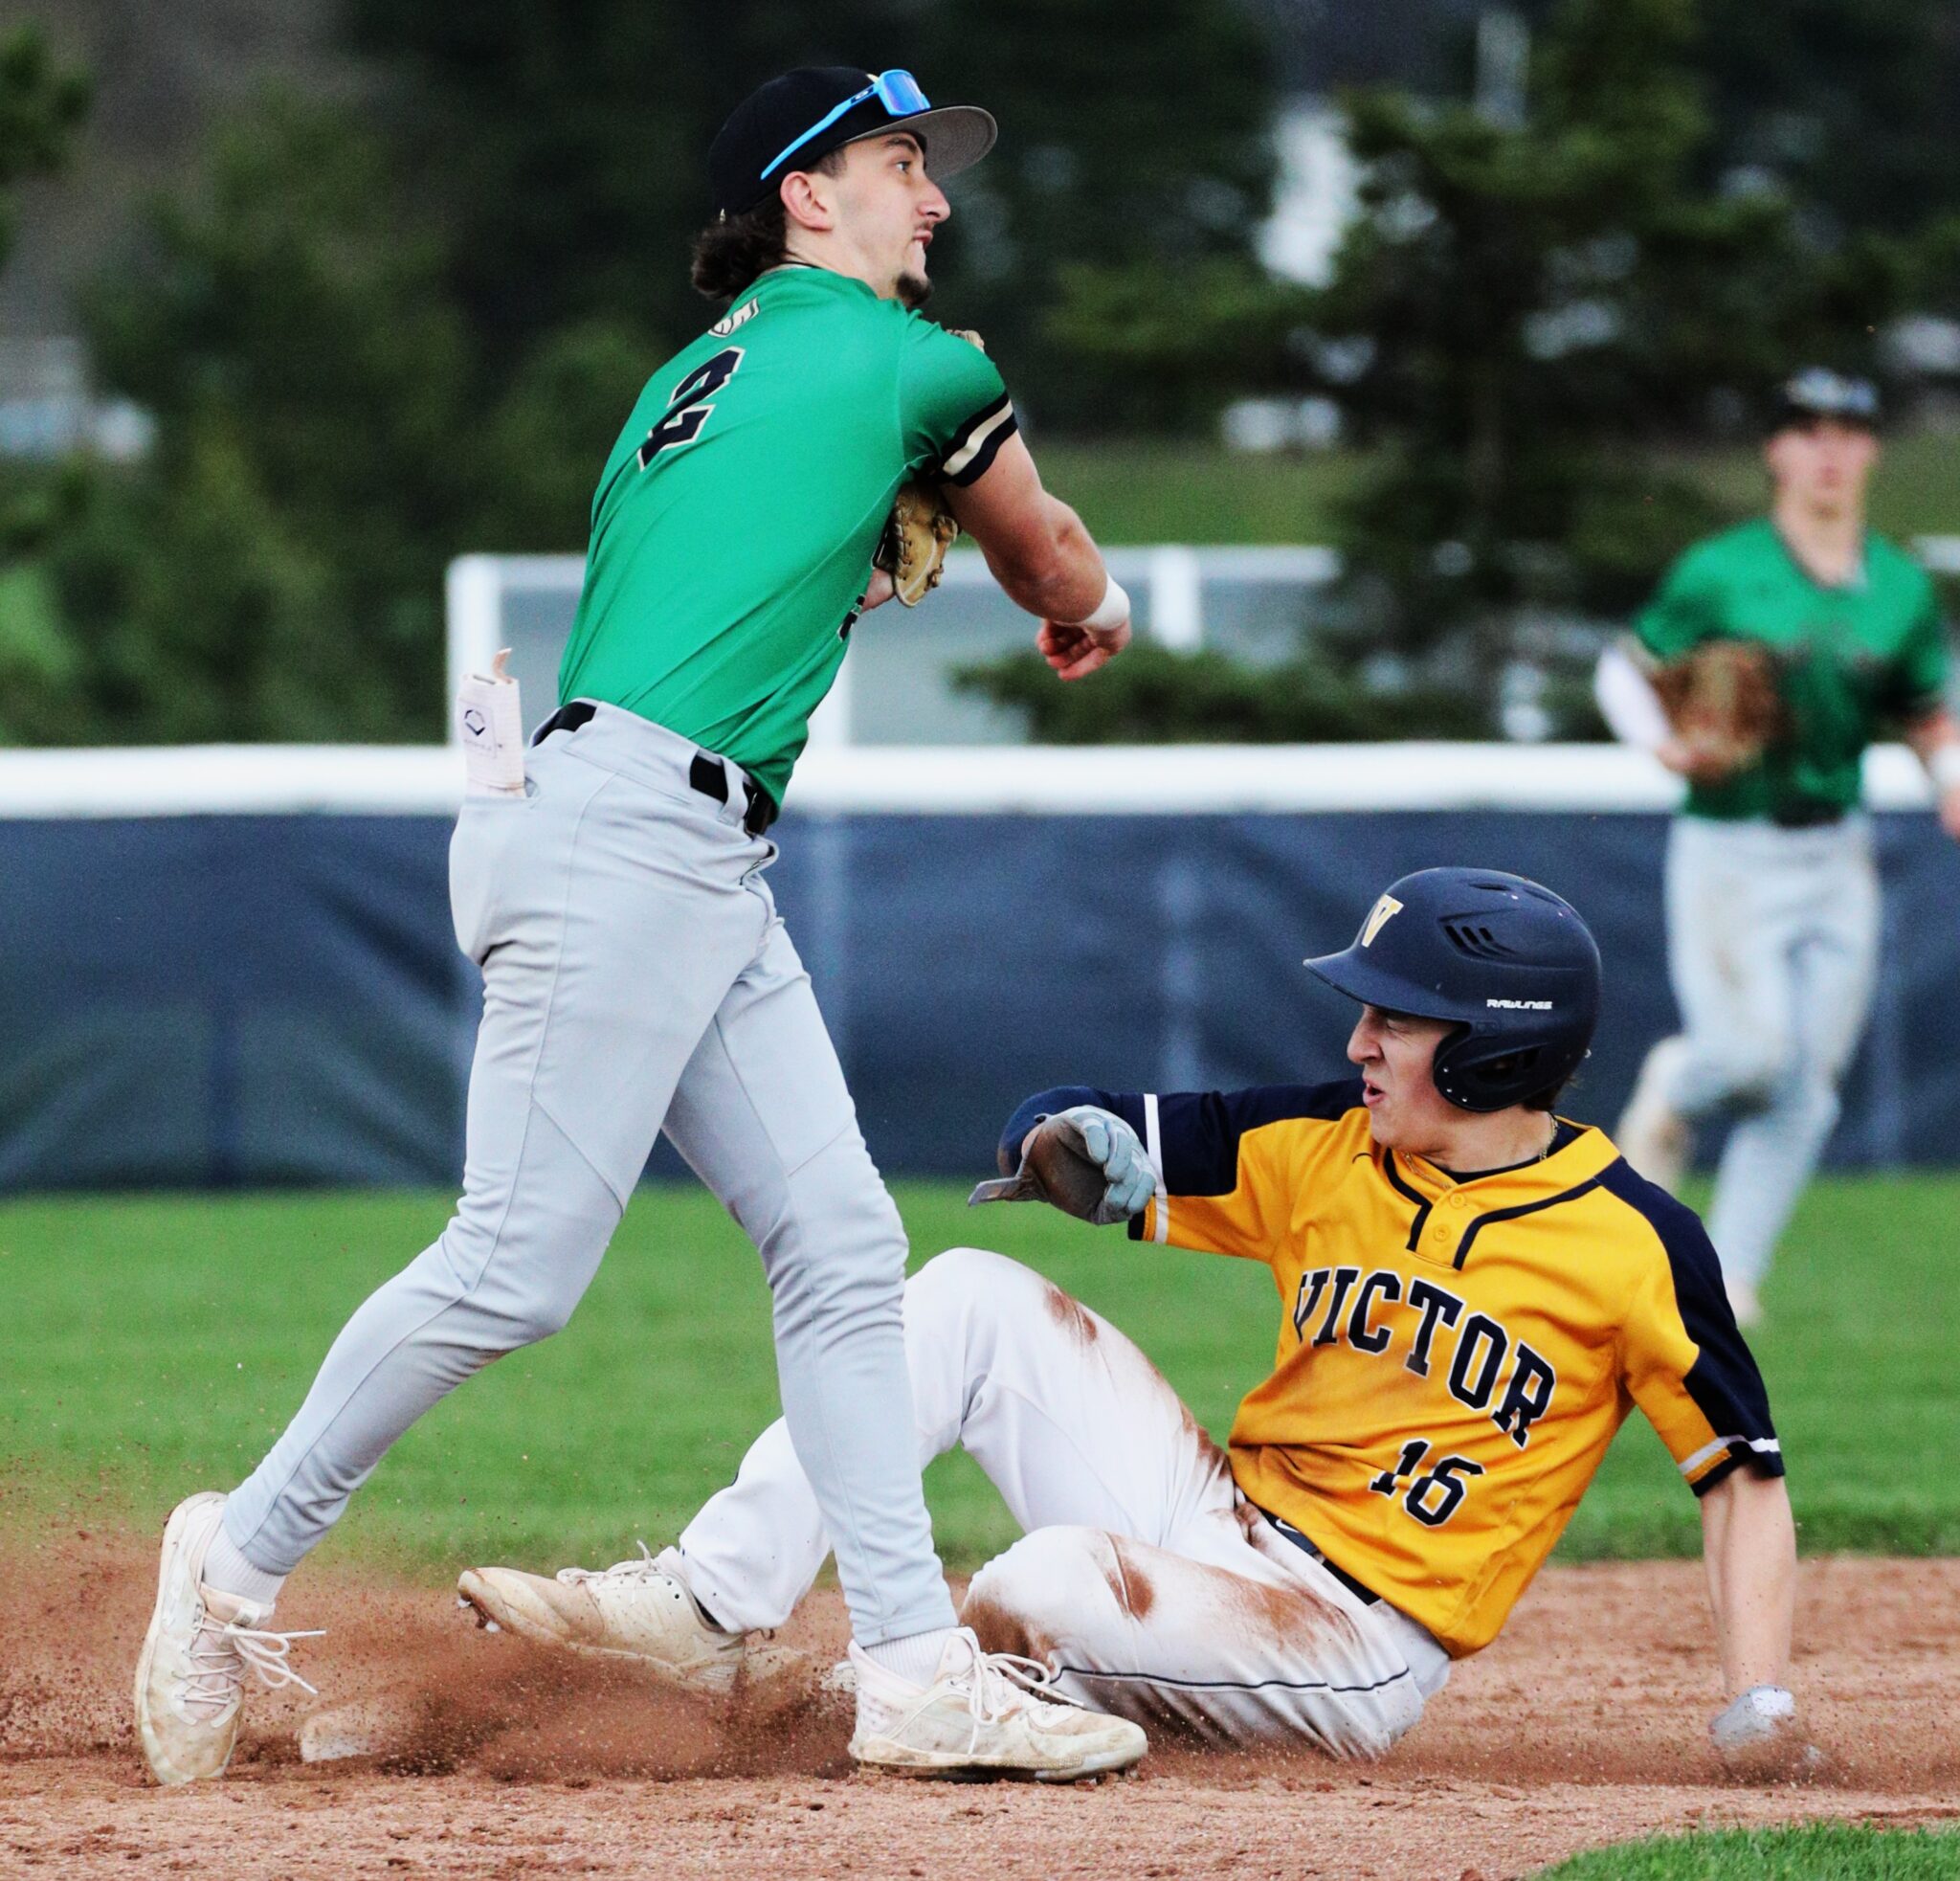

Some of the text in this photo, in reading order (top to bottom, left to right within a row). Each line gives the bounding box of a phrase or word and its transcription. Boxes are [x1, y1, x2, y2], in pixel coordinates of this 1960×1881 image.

[637, 346, 746, 472] 2
[1361, 893, 1404, 948] V
[1486, 998, 1553, 1011] RAWLINGS
[1294, 1266, 1557, 1451] VICTOR
[1370, 1438, 1486, 1527] 16
